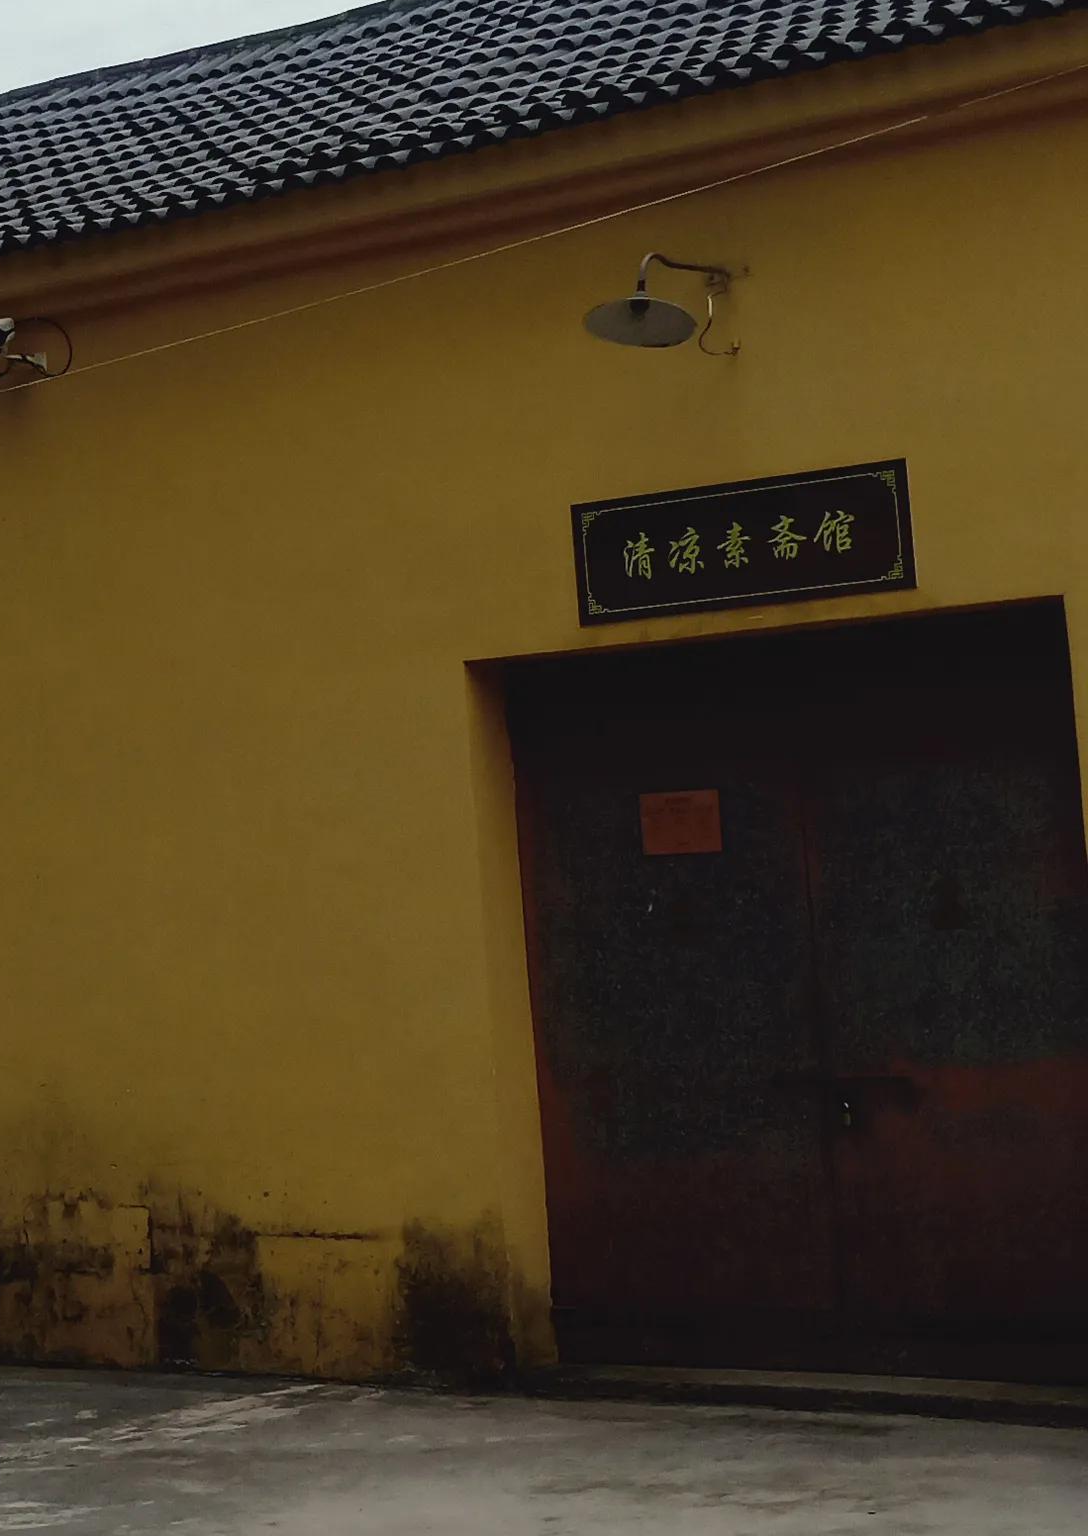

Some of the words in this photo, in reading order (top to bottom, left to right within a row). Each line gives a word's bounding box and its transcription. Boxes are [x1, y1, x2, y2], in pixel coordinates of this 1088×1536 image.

[623, 510, 855, 580] 清凉素斋馆
